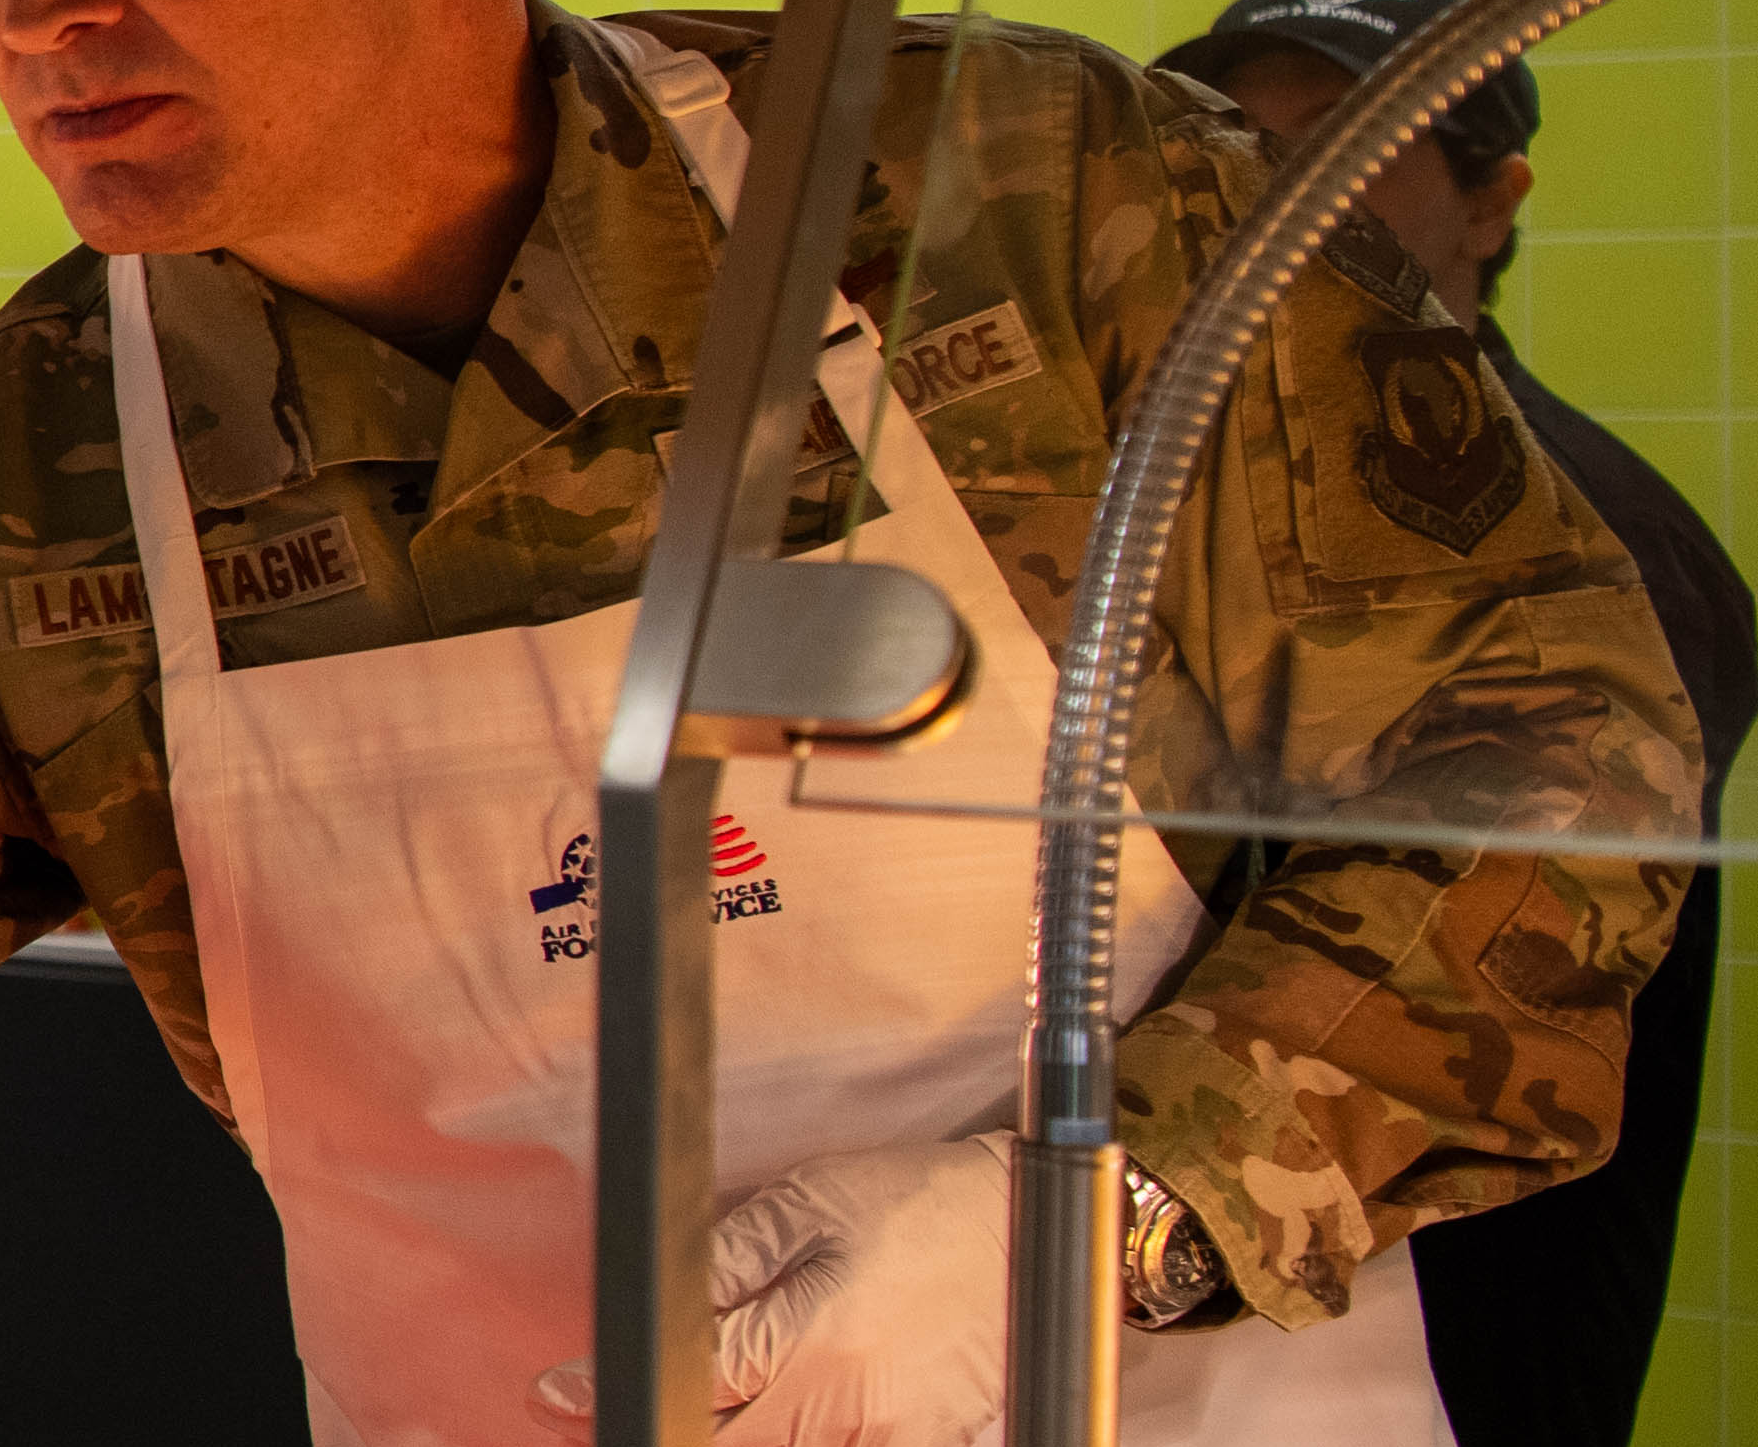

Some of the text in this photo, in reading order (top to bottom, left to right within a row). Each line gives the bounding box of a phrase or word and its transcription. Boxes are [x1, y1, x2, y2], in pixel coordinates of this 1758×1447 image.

[891, 320, 1014, 408] ORCE
[33, 527, 346, 636] LAMTAGNE
[541, 923, 582, 941] AIR
[711, 878, 778, 901] VICES
[710, 892, 783, 925] VICE
